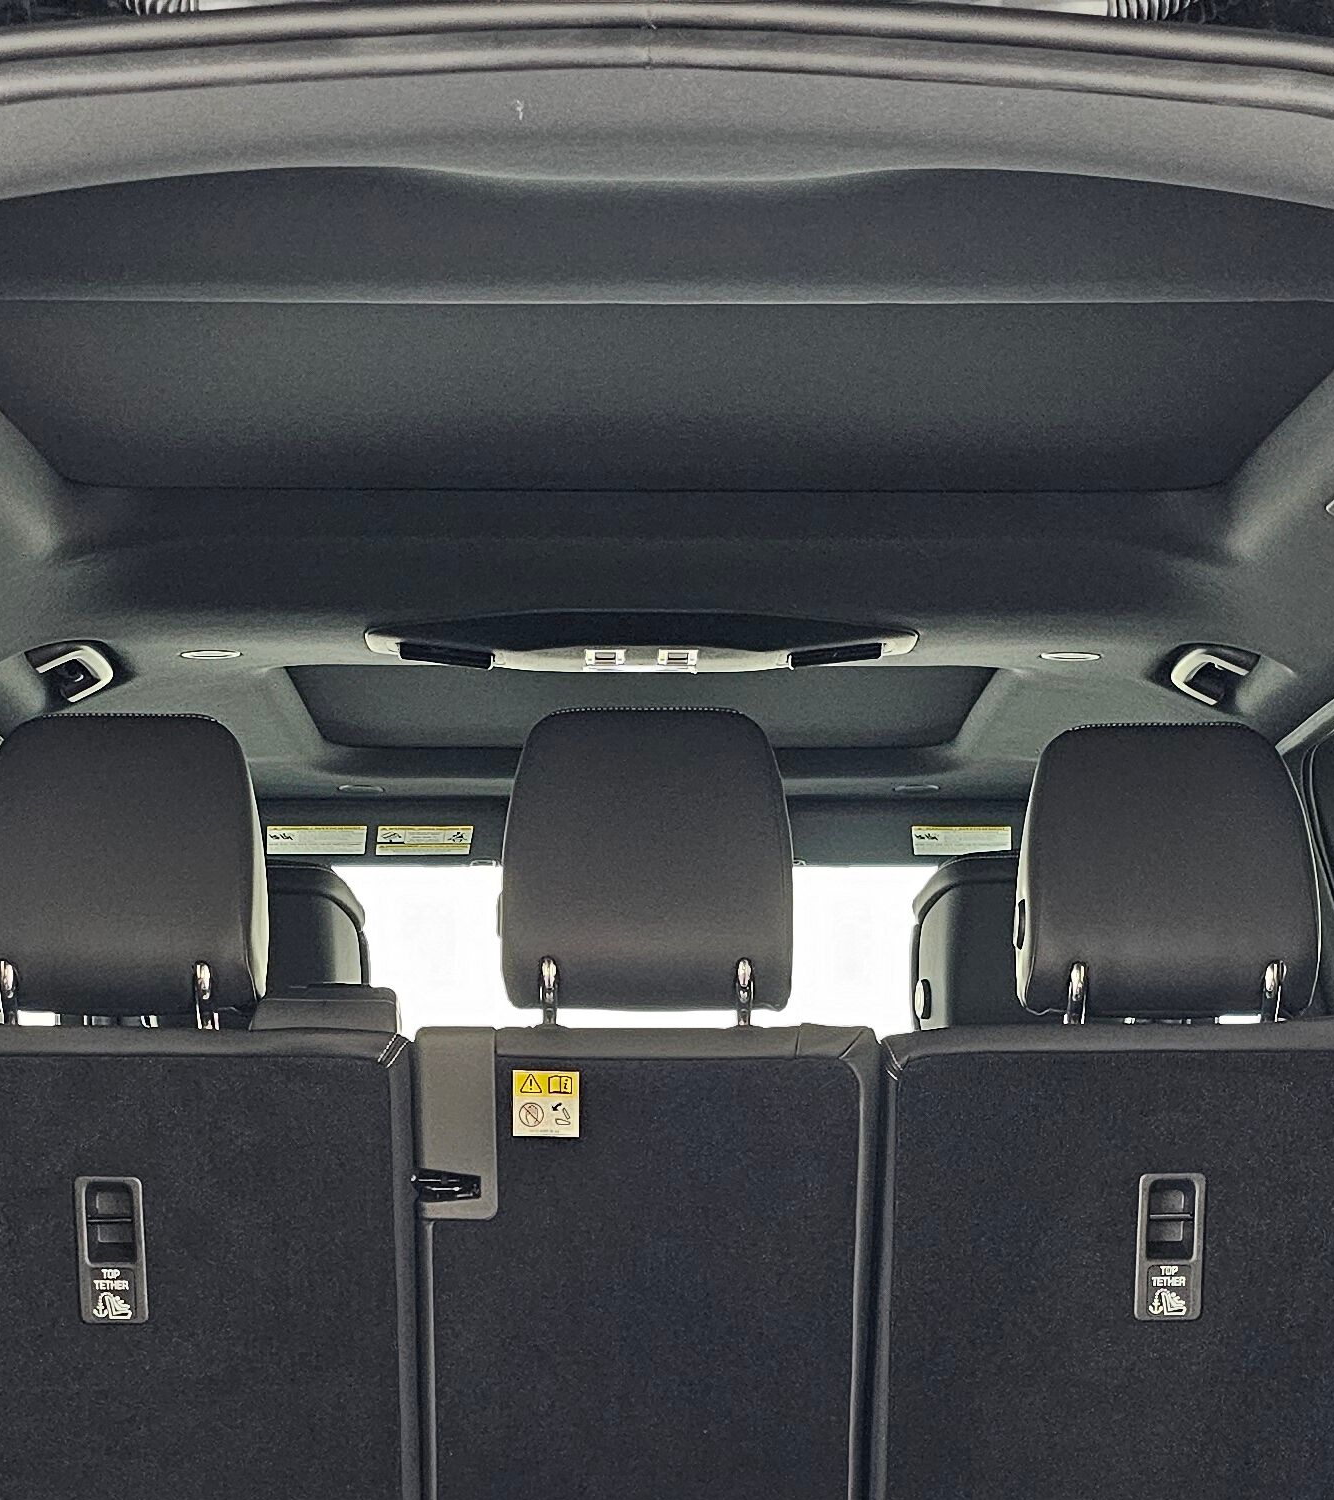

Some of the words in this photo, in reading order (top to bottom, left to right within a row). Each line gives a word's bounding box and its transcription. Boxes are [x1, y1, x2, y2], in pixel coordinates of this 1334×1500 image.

[101, 1269, 121, 1279] TOP
[1160, 1266, 1179, 1276] TOP
[93, 1280, 129, 1290] TETHER
[1151, 1276, 1186, 1287] TETHER
